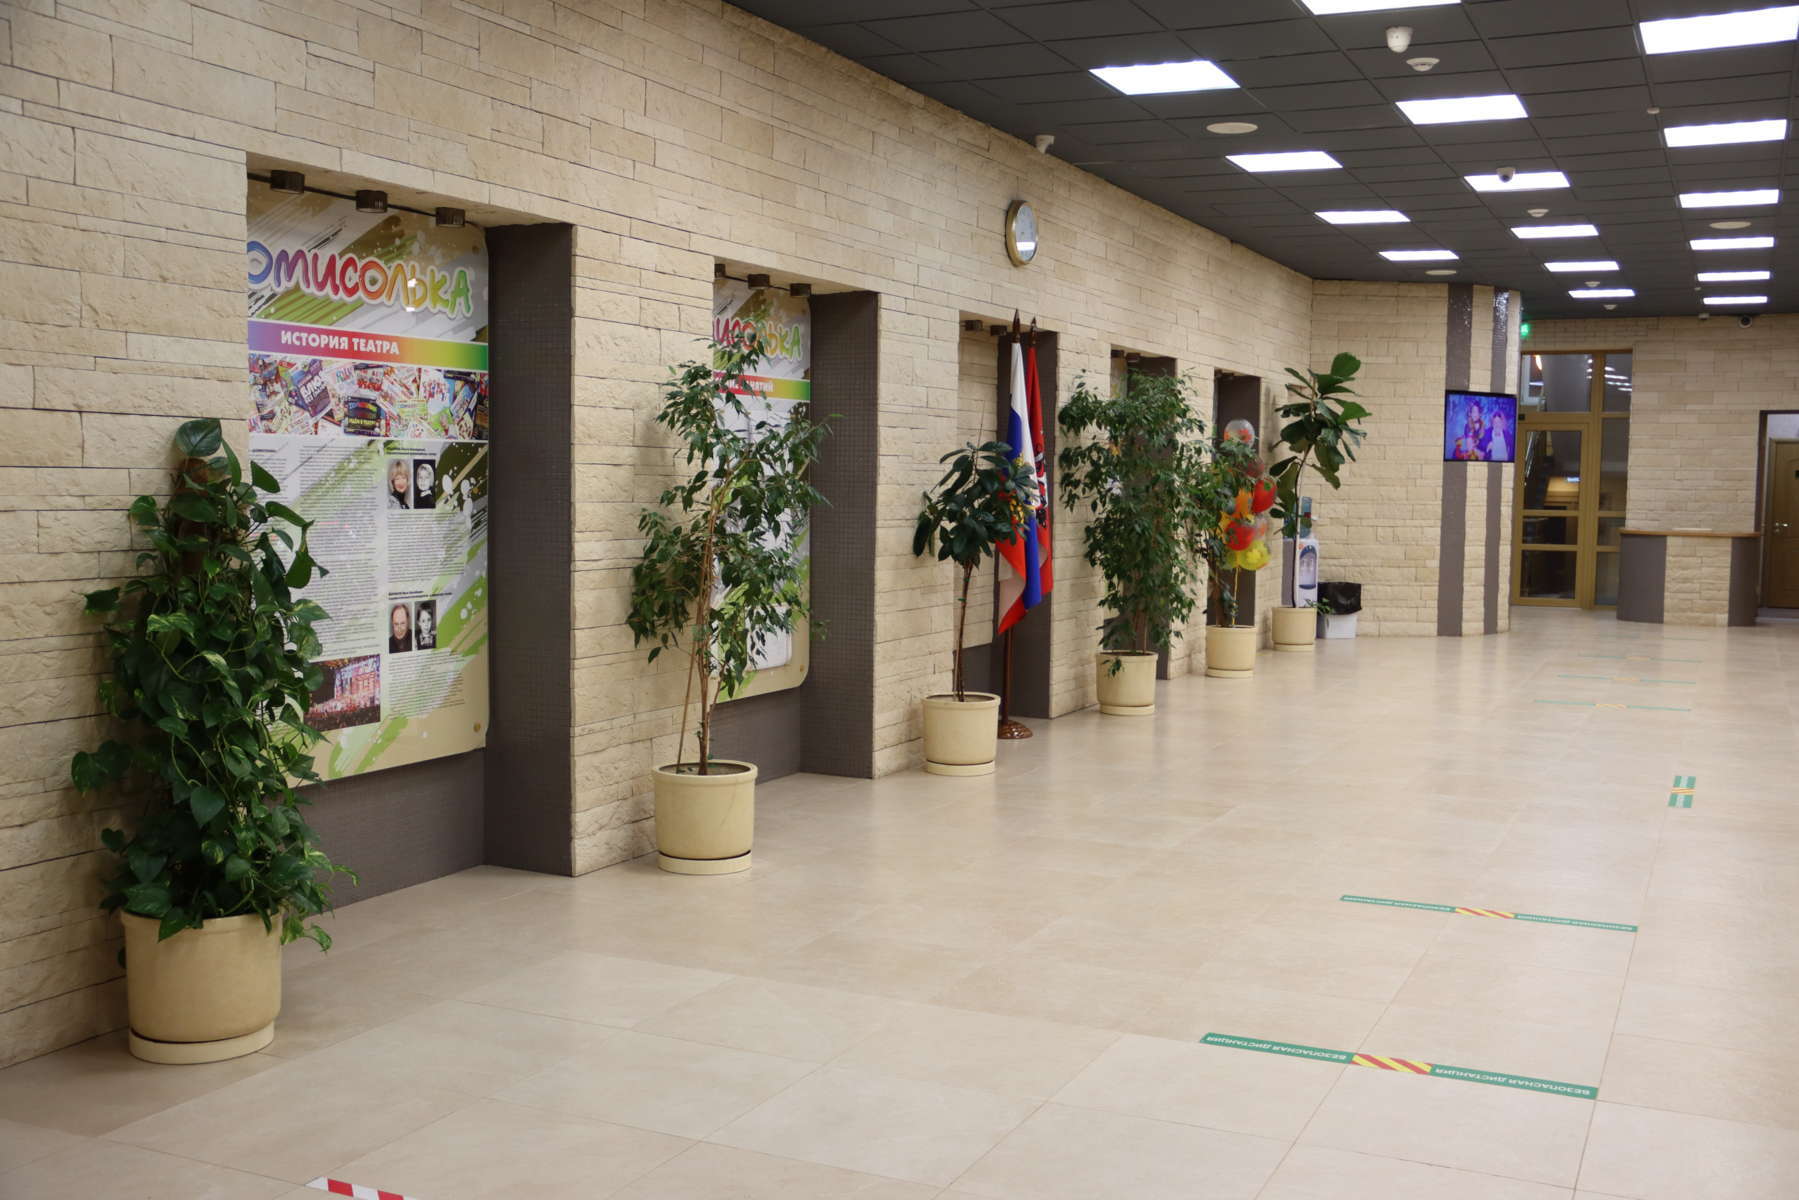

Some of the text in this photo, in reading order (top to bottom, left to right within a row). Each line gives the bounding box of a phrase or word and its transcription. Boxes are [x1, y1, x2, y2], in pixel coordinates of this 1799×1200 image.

[281, 330, 400, 355] ИСТОРИЯ ТЕАТРА
[1205, 1035, 1347, 1061] БЕЗОПАСНАЯ ДИСТАНЦИЯ
[1434, 1067, 1591, 1096] БЕЗОПАСНАЯ ДИСТАНЦИЯ
